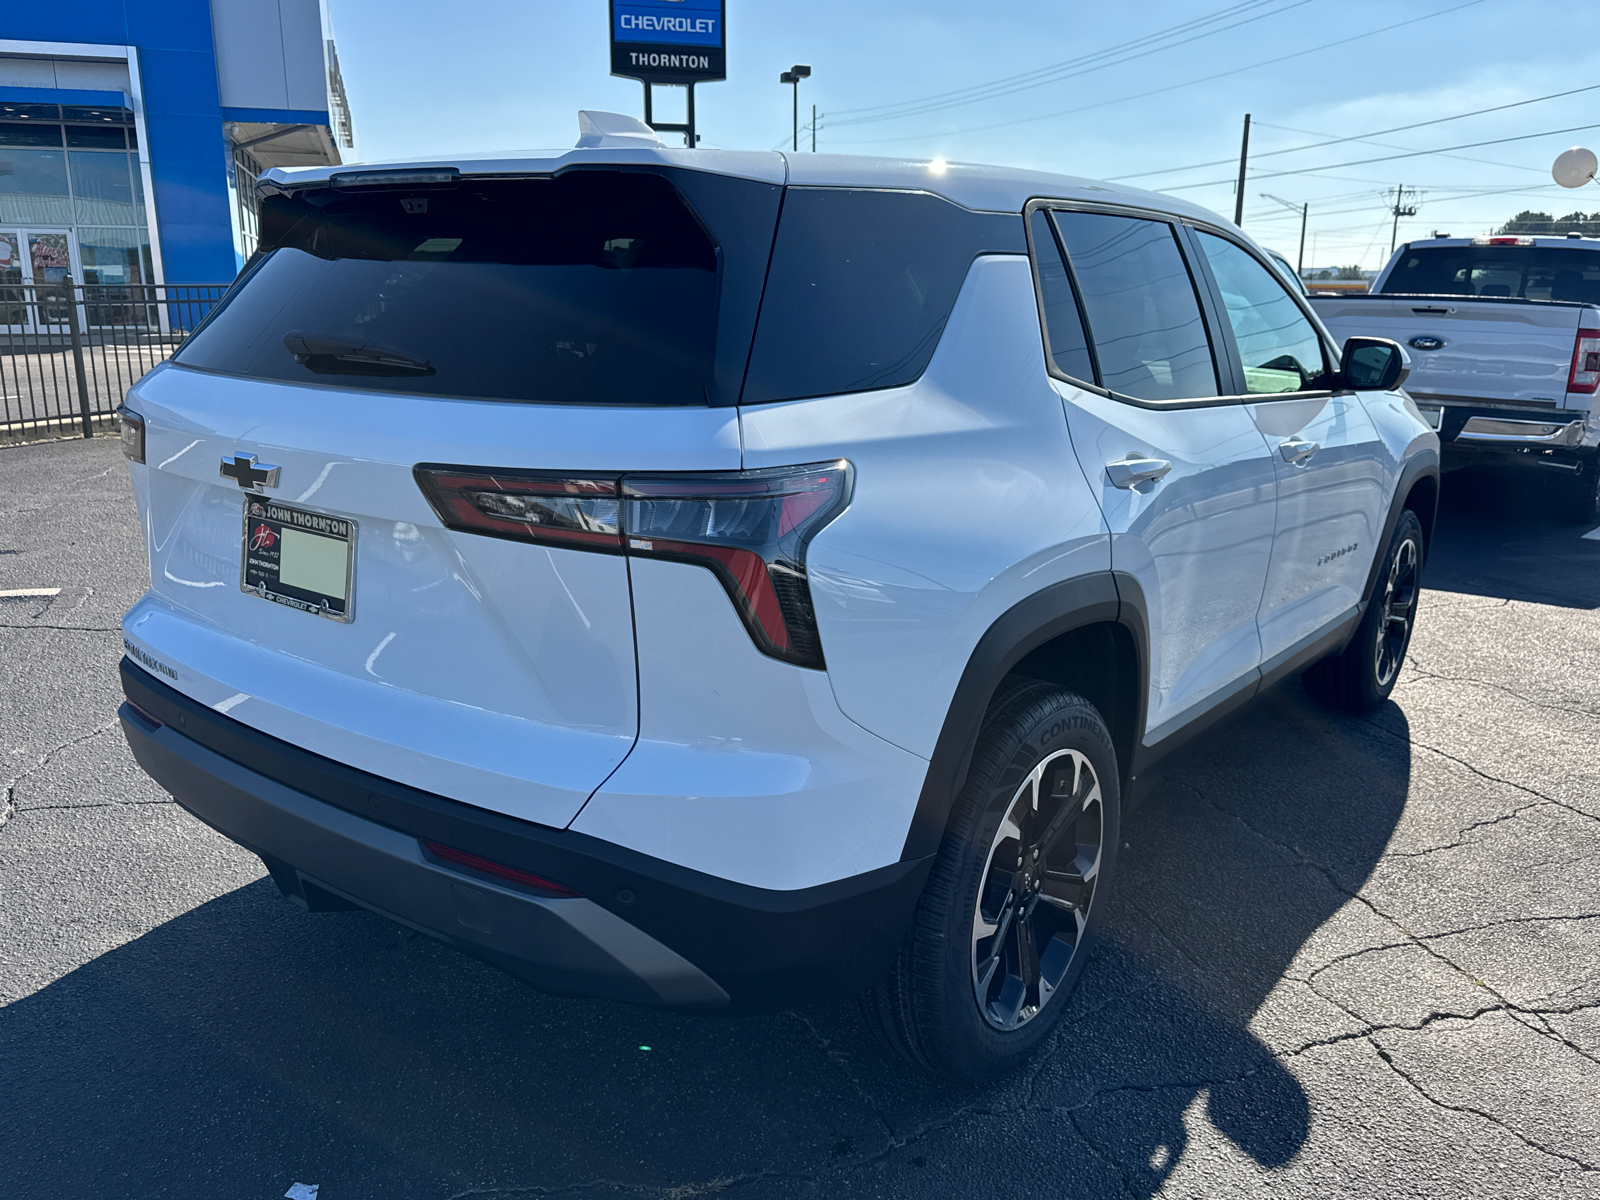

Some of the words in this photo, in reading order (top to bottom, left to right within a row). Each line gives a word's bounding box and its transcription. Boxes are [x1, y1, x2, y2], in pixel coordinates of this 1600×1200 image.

[621, 14, 715, 33] CHEVROLET
[630, 52, 709, 69] THORNTON
[31, 242, 61, 258] Merry
[266, 506, 291, 522] JOHN
[293, 514, 347, 535] THORNTON
[259, 560, 279, 570] THORNTON
[276, 595, 307, 610] CHEVROLET
